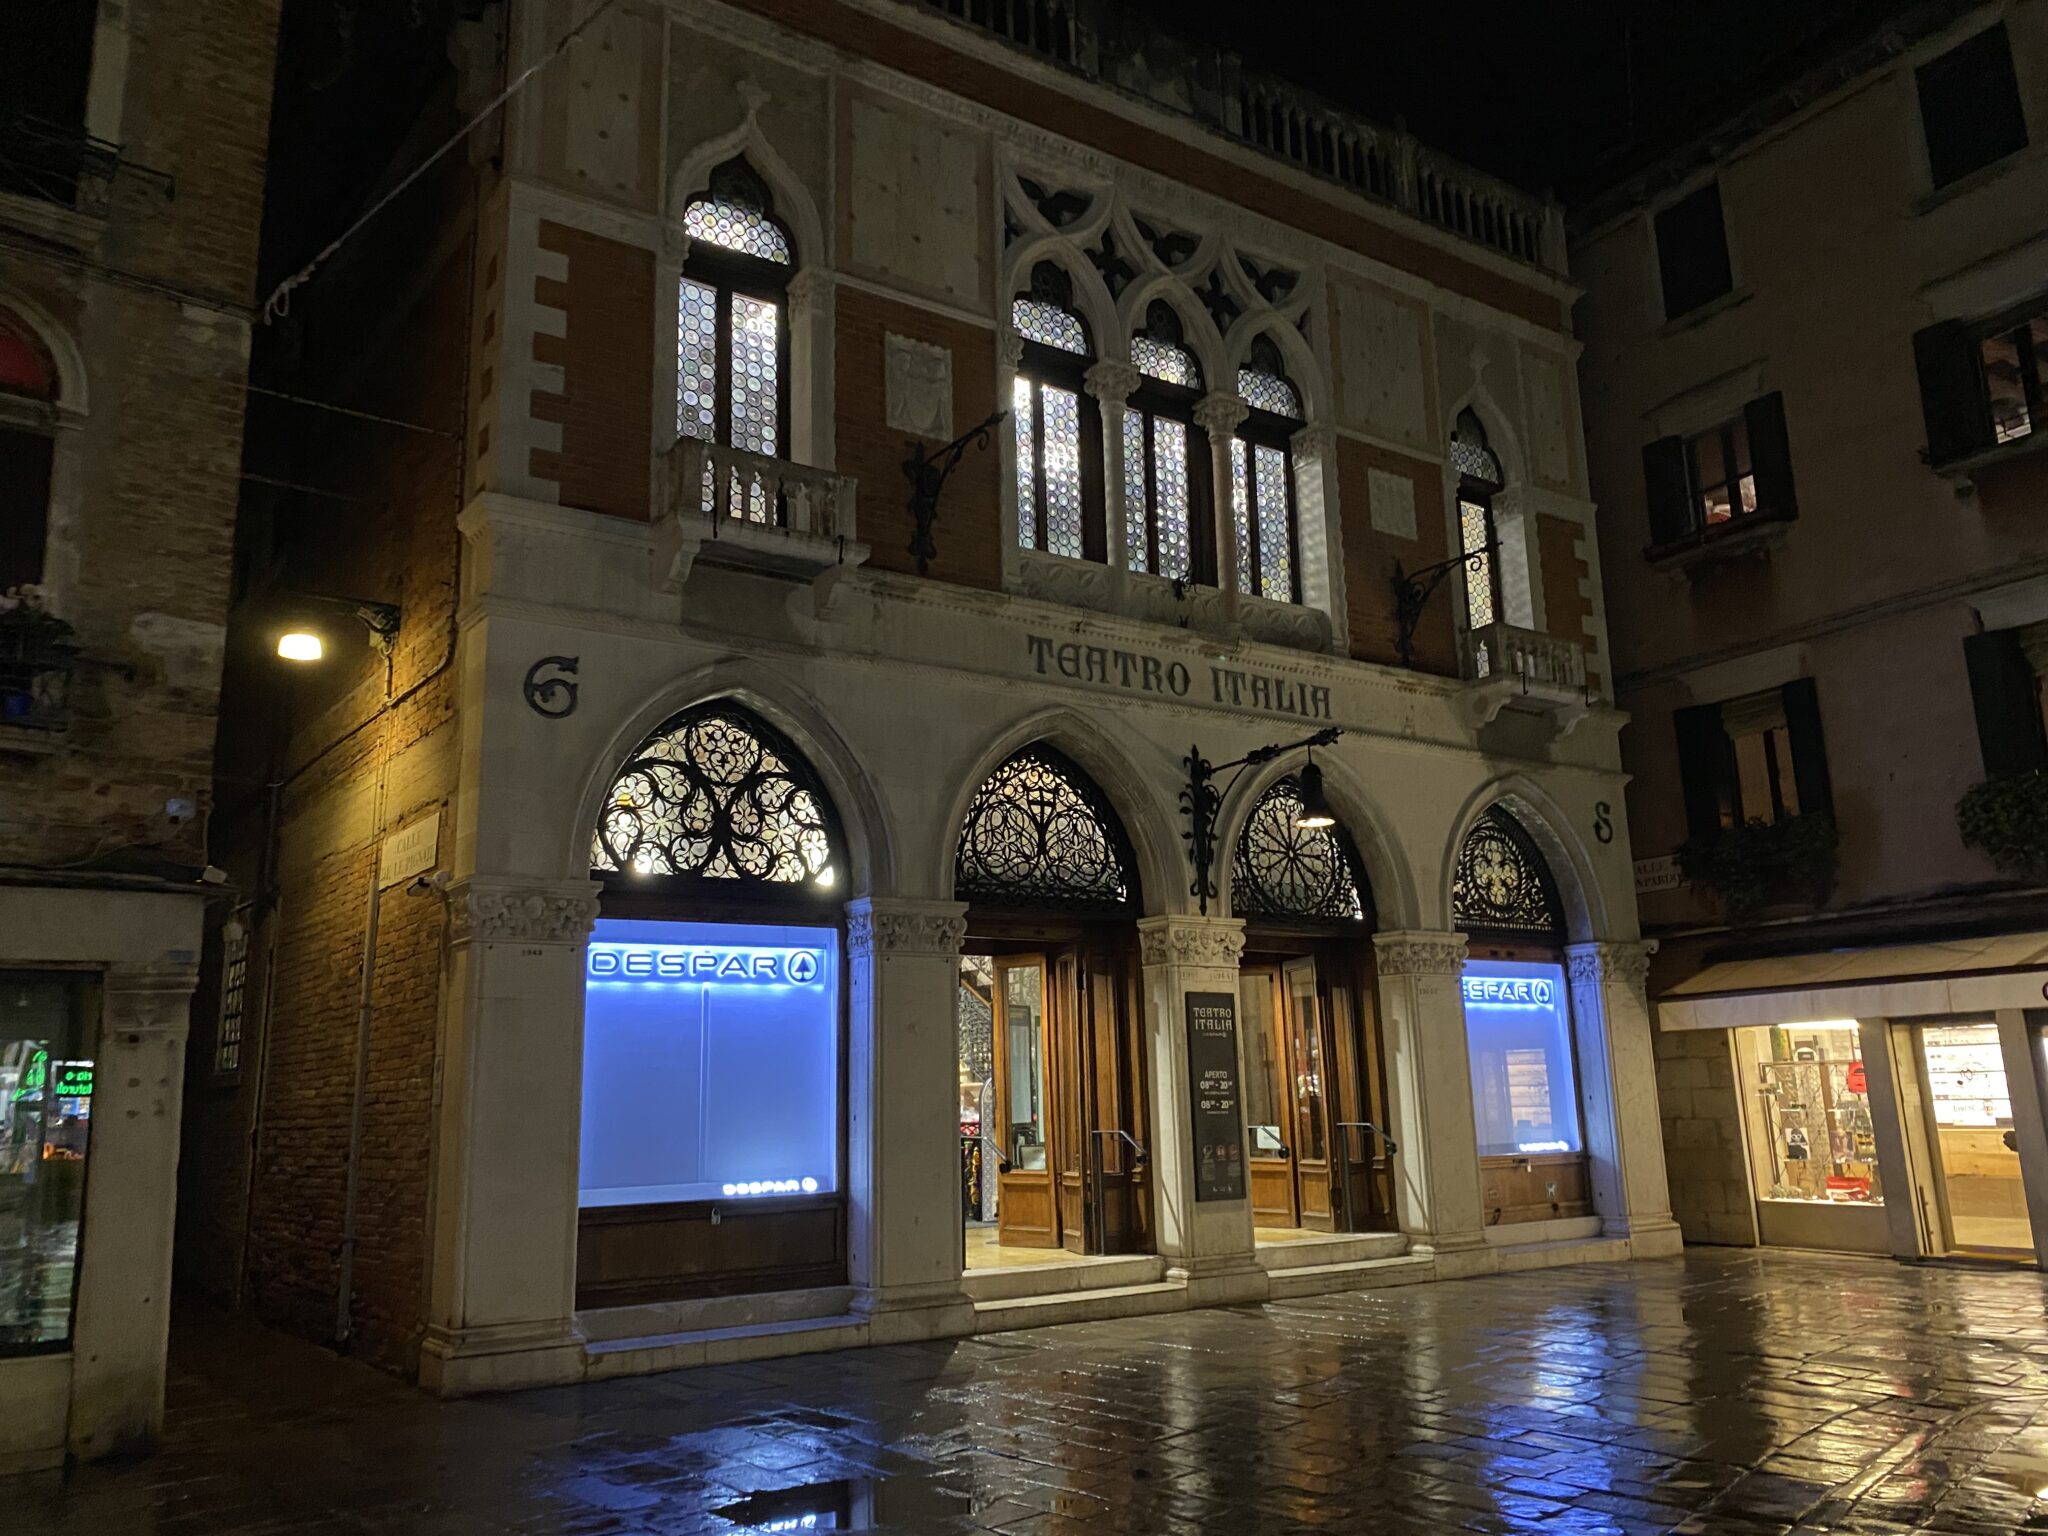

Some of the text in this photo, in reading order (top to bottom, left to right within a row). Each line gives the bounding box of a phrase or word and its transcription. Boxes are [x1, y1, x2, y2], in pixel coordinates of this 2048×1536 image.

[1026, 634, 1333, 720] TEATRO ITALIA
[590, 951, 778, 977] DESPAR
[1463, 980, 1530, 1000] SPAR
[1193, 1007, 1232, 1019] TEATRO
[1195, 1019, 1233, 1031] ITALIA
[1204, 1070, 1228, 1079] APERTO
